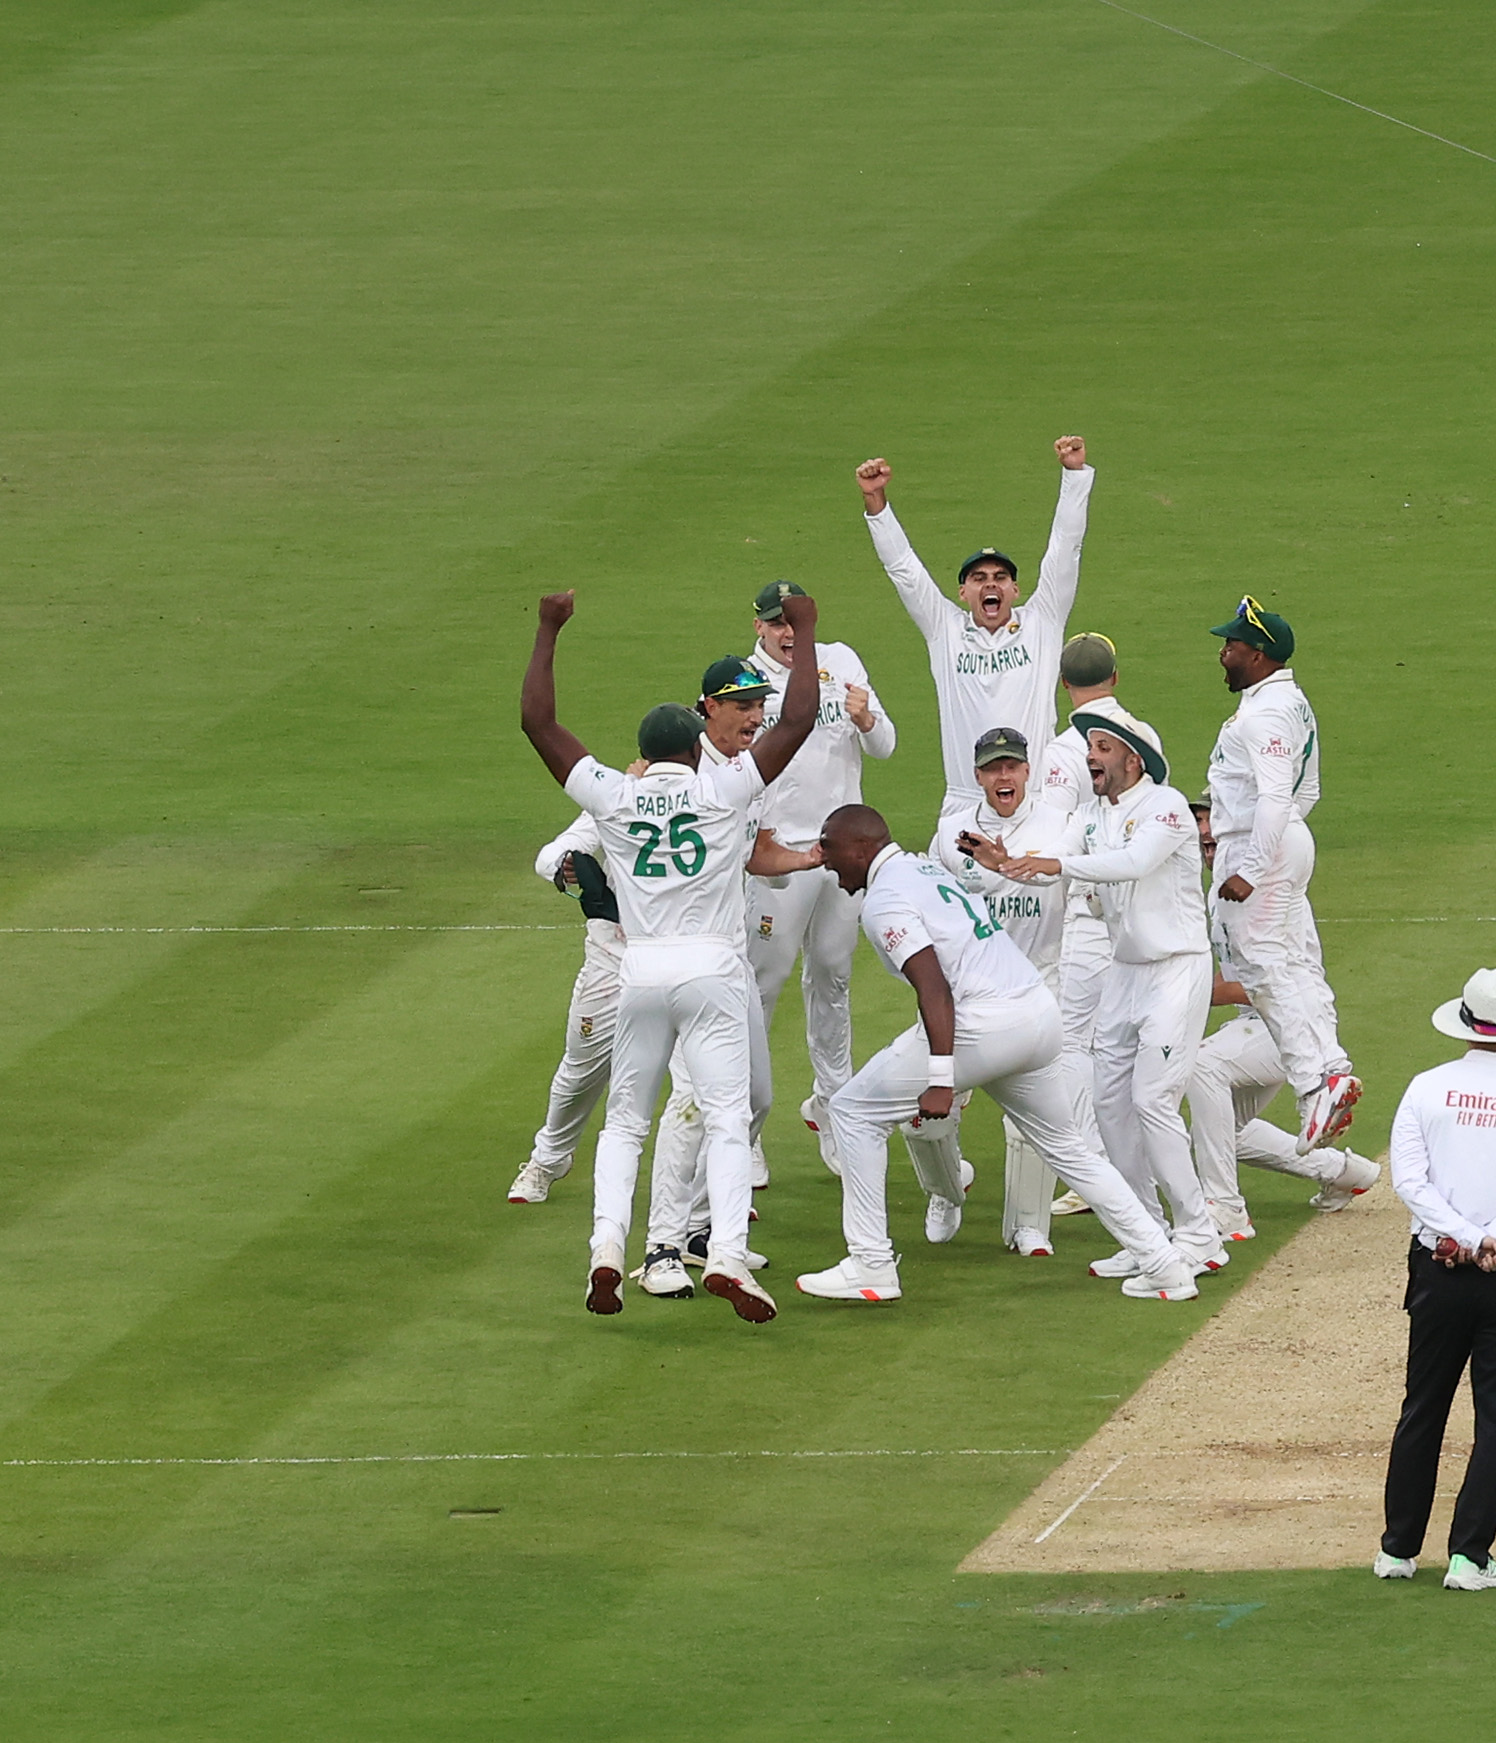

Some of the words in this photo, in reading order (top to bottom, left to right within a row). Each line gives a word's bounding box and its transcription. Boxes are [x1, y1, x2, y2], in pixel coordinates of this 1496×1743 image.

[956, 652, 989, 676] SOUTH
[991, 644, 1032, 674] AFRICA
[816, 700, 843, 727] RICA
[1260, 746, 1292, 756] CASTLE
[627, 813, 707, 877] 25
[998, 896, 1041, 918] AFRICA
[885, 927, 909, 953] CASTLE
[1456, 1110, 1474, 1126] FLY
